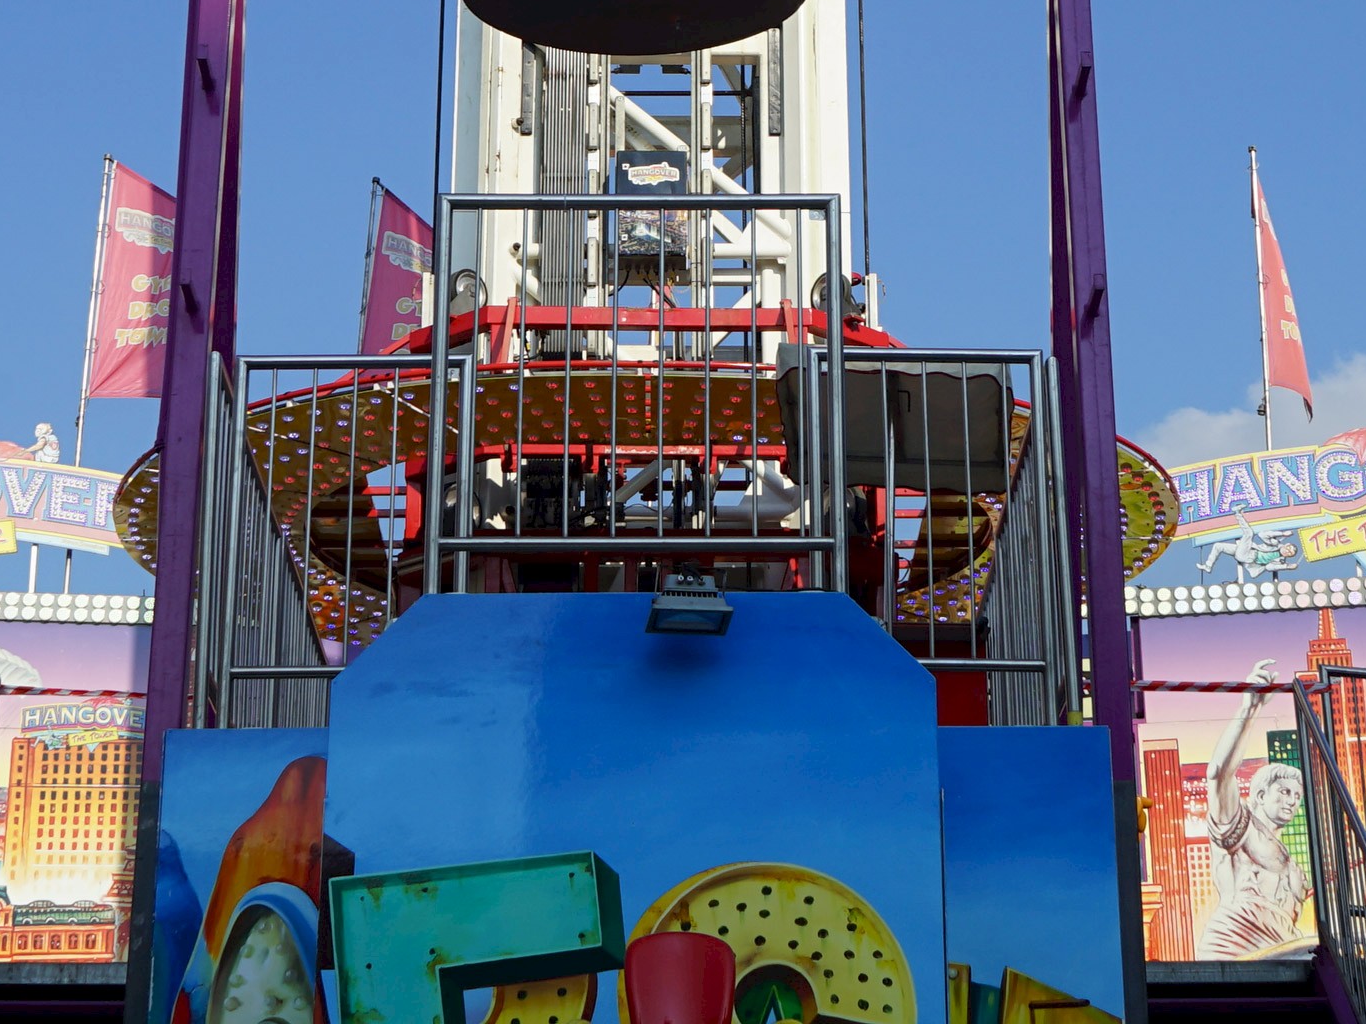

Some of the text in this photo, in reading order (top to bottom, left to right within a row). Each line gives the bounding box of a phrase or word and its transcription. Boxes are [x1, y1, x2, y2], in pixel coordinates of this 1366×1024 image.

[119, 212, 174, 236] HANGO
[1308, 528, 1353, 555] THE
[24, 706, 145, 729] HANGOVE
